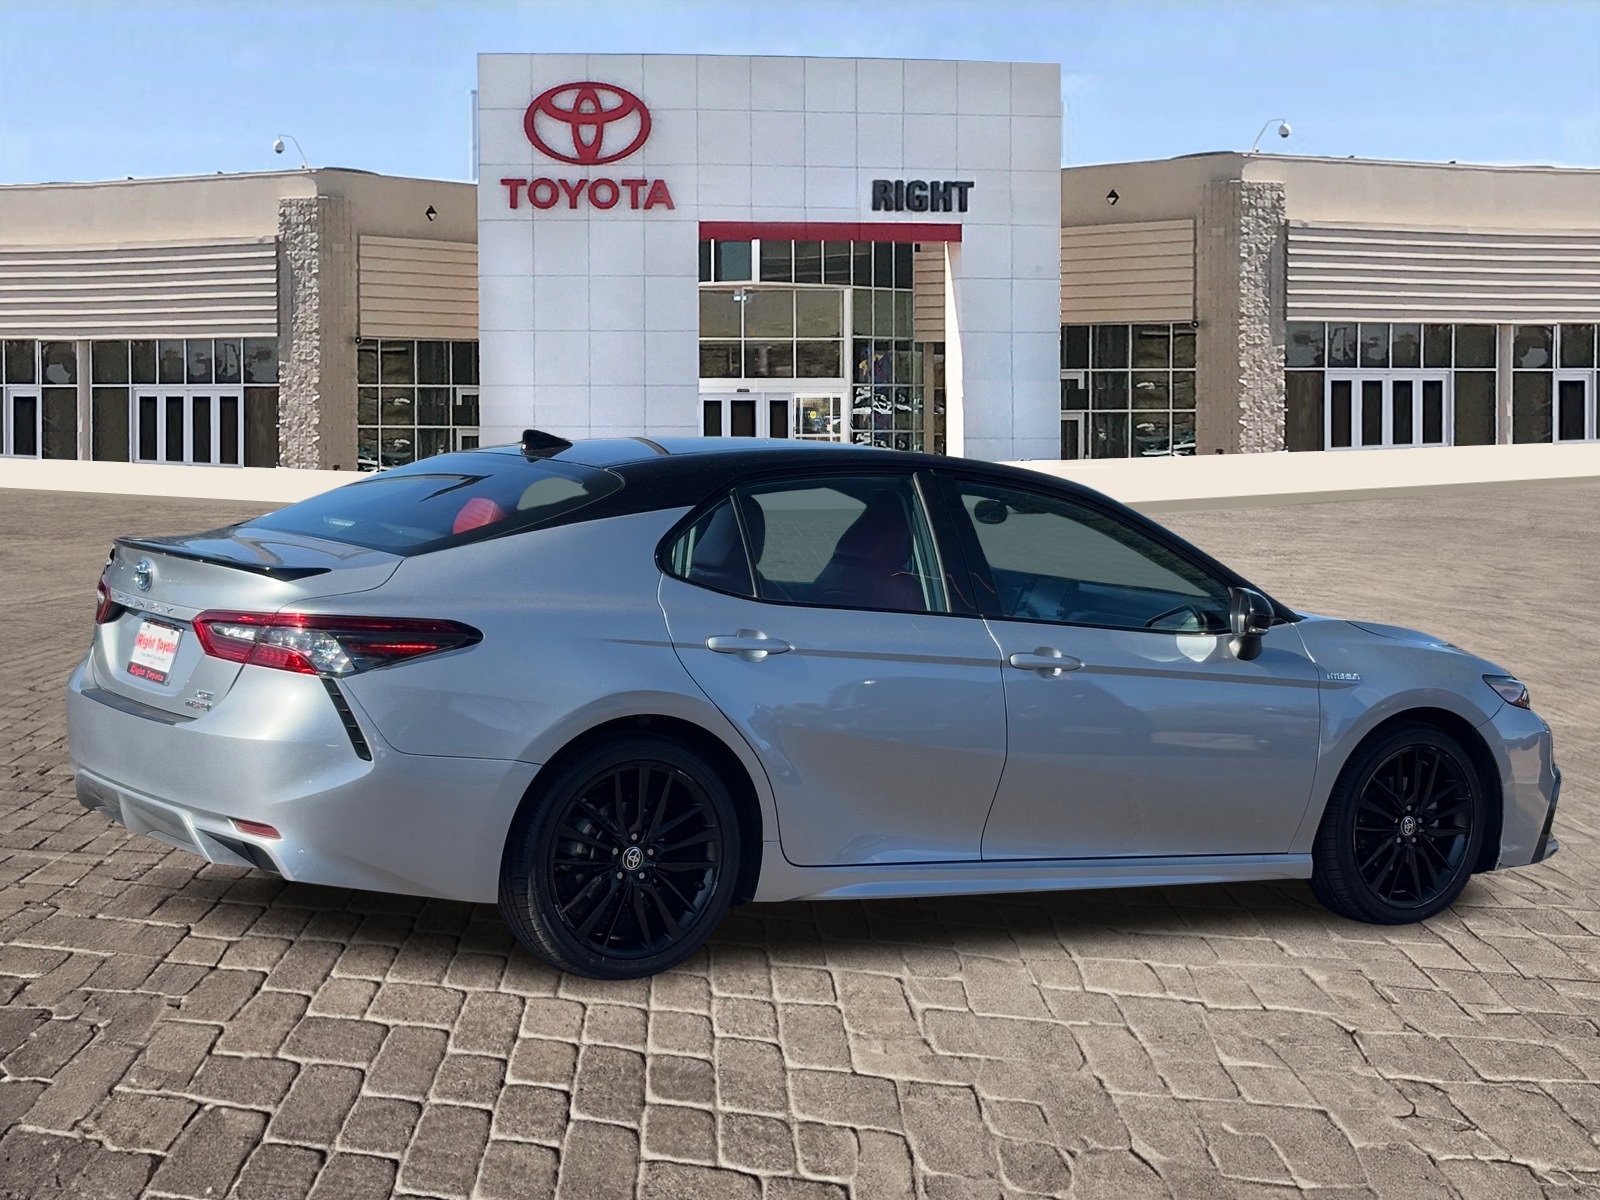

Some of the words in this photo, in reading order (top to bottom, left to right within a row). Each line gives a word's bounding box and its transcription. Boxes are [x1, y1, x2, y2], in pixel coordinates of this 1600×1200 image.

[500, 178, 676, 210] TOYOTA
[872, 179, 975, 212] RIGHT
[136, 633, 155, 650] Right
[156, 638, 177, 654] Toyota
